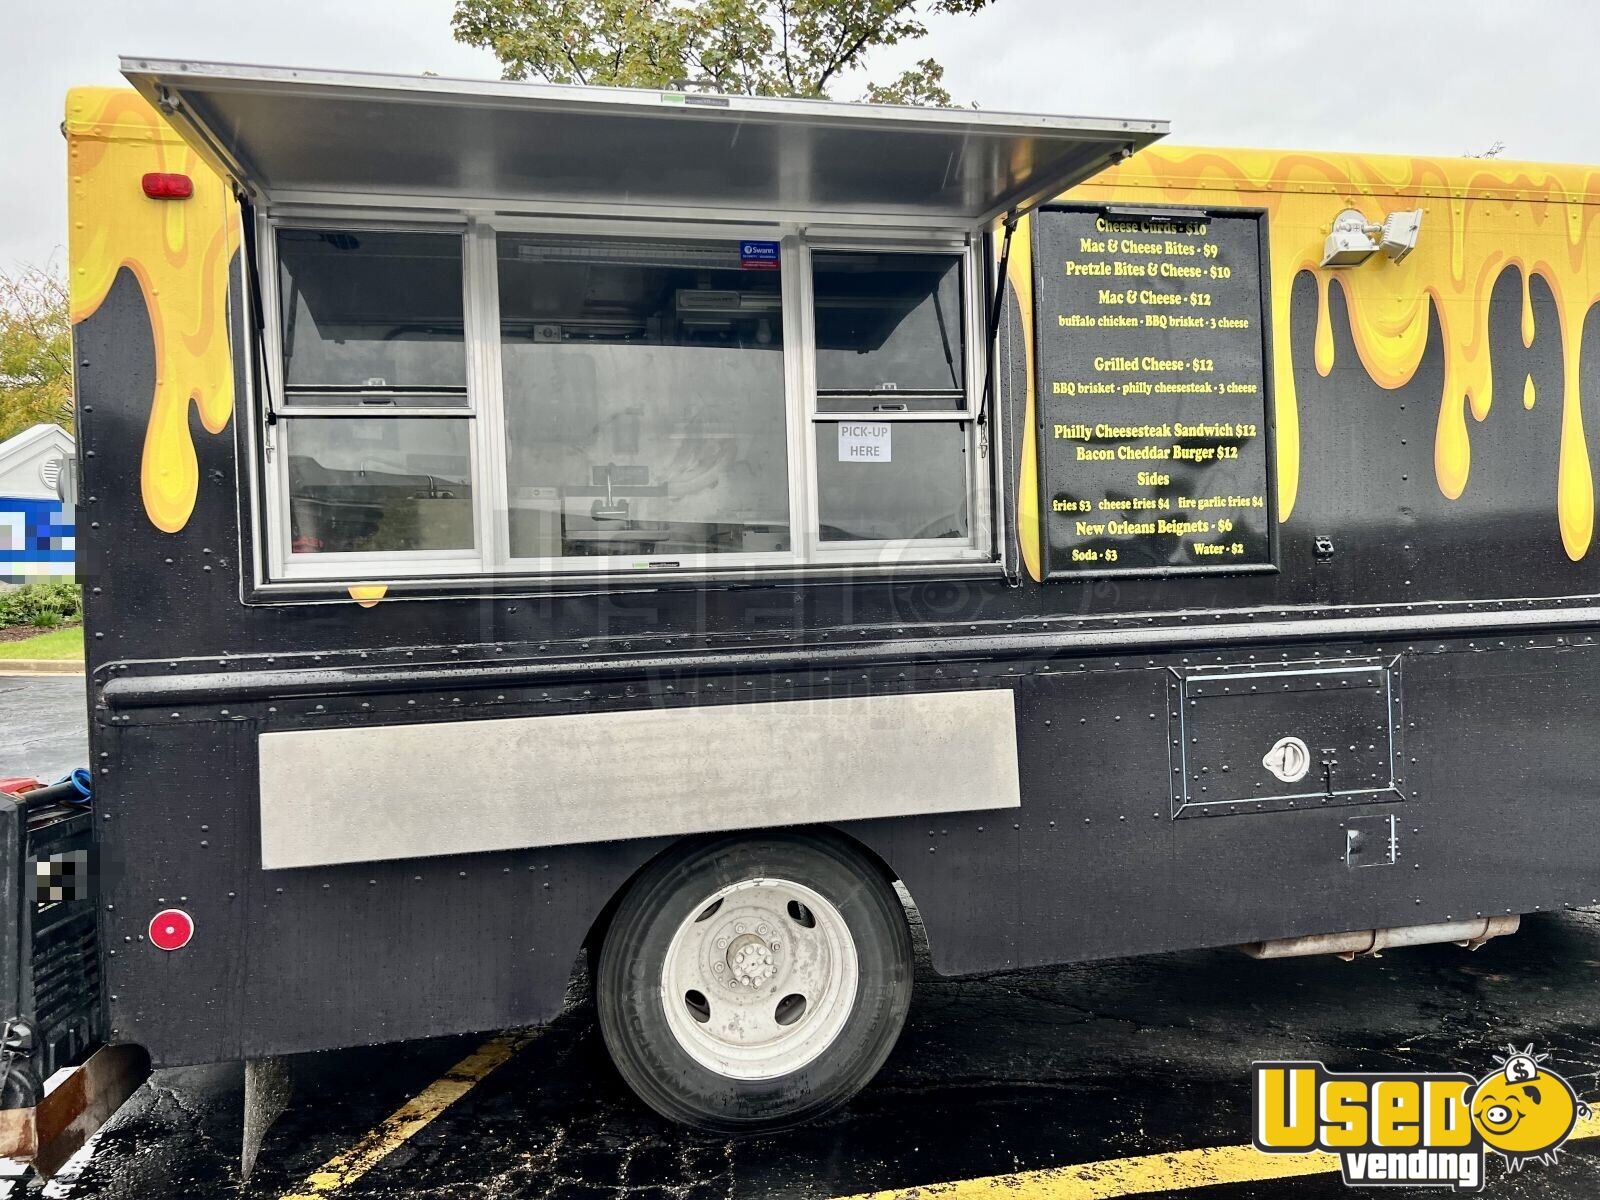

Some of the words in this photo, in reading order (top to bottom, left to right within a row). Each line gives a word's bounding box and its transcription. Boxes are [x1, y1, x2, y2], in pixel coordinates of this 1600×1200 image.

[1096, 218, 1138, 233] Cheese
[1141, 221, 1177, 234] Curds
[1186, 223, 1207, 236] $10
[752, 246, 774, 254] Swann
[1080, 239, 1106, 253] Mac
[1106, 240, 1119, 253] &
[1120, 240, 1163, 255] Cheese
[1164, 241, 1196, 255] Bites
[1203, 244, 1218, 258] $9
[1066, 261, 1112, 276] Pretzle
[1113, 261, 1146, 277] Bites
[1147, 263, 1159, 276] &
[1160, 263, 1202, 278] Cheese
[1210, 265, 1231, 279] $10
[1098, 290, 1125, 305] Mac
[1126, 291, 1139, 304] &
[1139, 289, 1182, 305] Cheese
[1190, 293, 1211, 306] $12
[1059, 315, 1096, 327] buffalo
[1097, 315, 1139, 328] chicken
[1145, 314, 1168, 328] BBQ
[1169, 317, 1205, 328] brisket
[1210, 318, 1217, 329] 3
[1218, 319, 1248, 328] cheese
[1094, 357, 1140, 371] Grilled
[1141, 357, 1184, 371] Cheese
[1192, 359, 1213, 372] $12
[1052, 382, 1076, 396] BBQ
[1077, 383, 1116, 394] brisket
[1122, 381, 1153, 395] philly
[1154, 382, 1213, 393] cheesesteak
[1219, 384, 1225, 394] 3
[1226, 383, 1257, 394] cheese
[841, 426, 888, 437] PICK-UP
[1054, 424, 1093, 441] Philly
[1095, 424, 1173, 438] Cheesesteak
[1174, 423, 1234, 438] Sandwich
[1235, 424, 1257, 438] $12
[850, 445, 880, 456] HERE
[1076, 446, 1116, 461] Bacon
[1117, 445, 1171, 460] Cheddar
[1173, 445, 1215, 462] Burger
[1217, 446, 1238, 460] $12
[1137, 471, 1169, 487] Sides
[1052, 500, 1077, 511] fries
[1079, 500, 1092, 512] $3
[1098, 500, 1131, 510] cheese
[1133, 499, 1156, 509] fries
[1158, 499, 1170, 510] $4
[1178, 497, 1197, 509] fire
[1198, 496, 1227, 511] garlic
[1228, 496, 1251, 507] fries
[1252, 496, 1263, 508] $4
[1076, 521, 1106, 536] New
[1107, 521, 1155, 535] Orleans
[1158, 520, 1210, 536] Beignets
[1217, 519, 1233, 533] $6
[1072, 550, 1097, 561] Soda
[1105, 549, 1117, 561] $3
[1194, 542, 1225, 555] Water
[1231, 544, 1243, 554] $2
